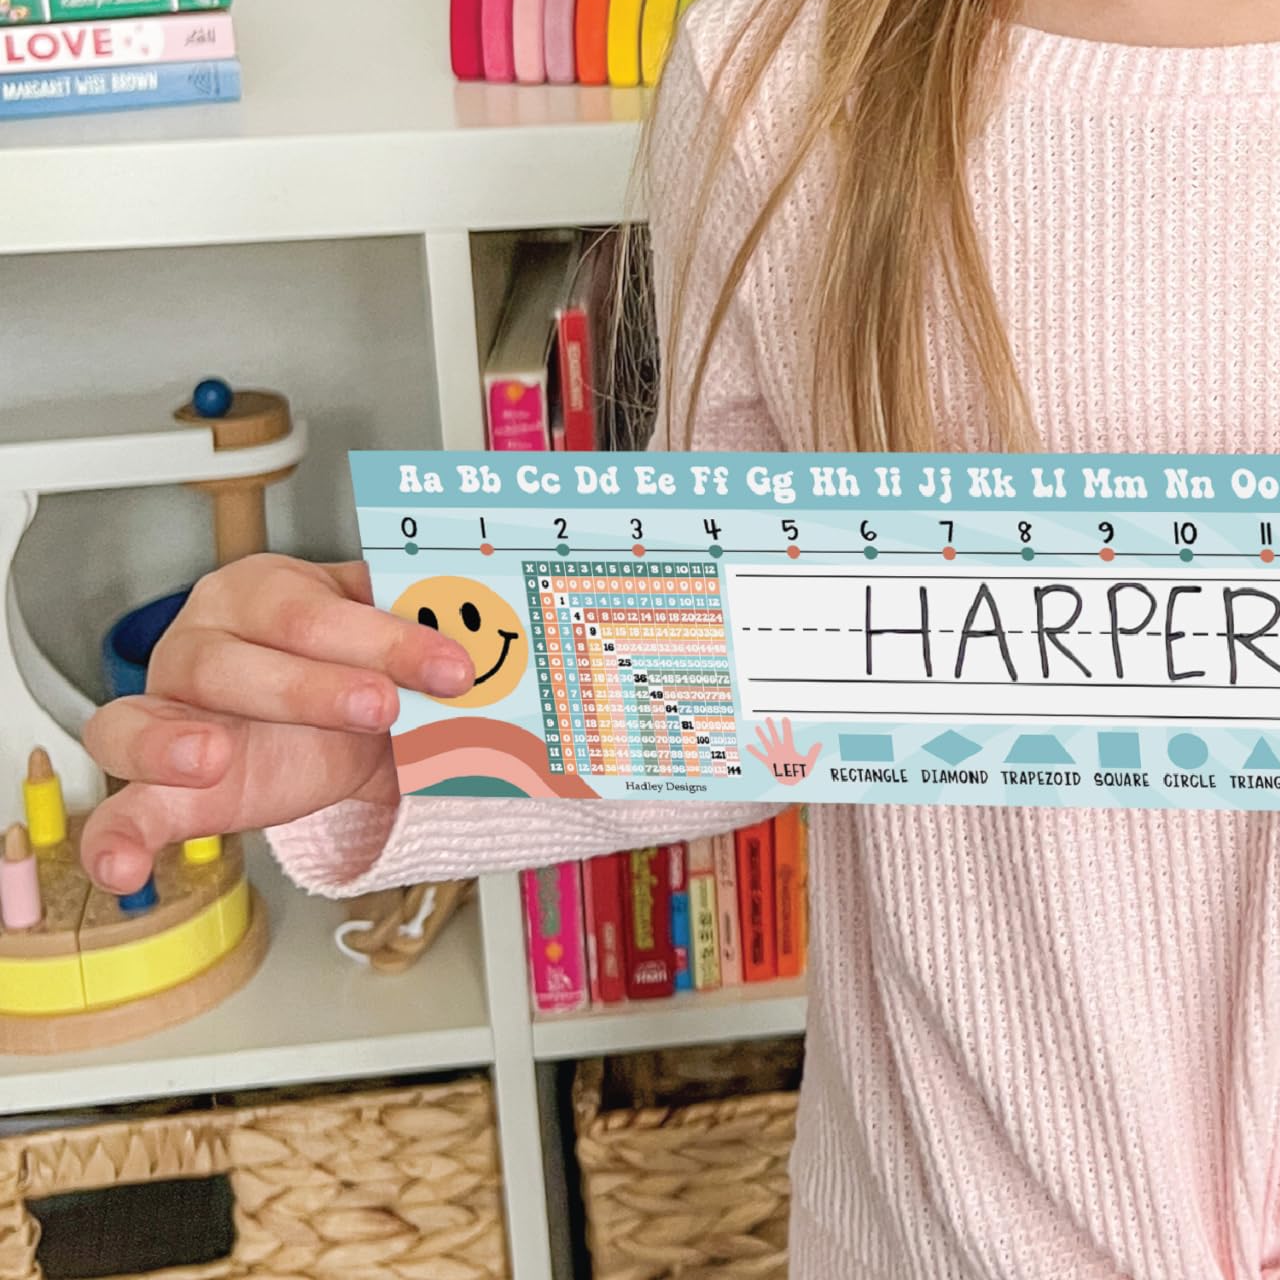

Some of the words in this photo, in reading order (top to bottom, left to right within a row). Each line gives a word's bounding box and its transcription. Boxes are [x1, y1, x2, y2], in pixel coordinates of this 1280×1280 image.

[5, 27, 113, 63] LOVE
[399, 464, 444, 493] Aa
[456, 465, 502, 494] Bb
[516, 465, 561, 494] Cc
[574, 465, 621, 495] Dd
[633, 465, 677, 495] Ee
[690, 466, 729, 495] Ff
[746, 466, 796, 504] Gg
[809, 466, 861, 497] Hh
[874, 466, 902, 497] Ii
[918, 467, 953, 504] Jj
[966, 467, 1017, 498] Kk
[1031, 467, 1067, 498] Ll
[1082, 467, 1148, 499] Mm
[1163, 468, 1215, 499] Nn
[1231, 468, 1280, 500] Oo
[401, 516, 418, 538] 0
[553, 517, 569, 539] 2
[630, 518, 643, 540] 3
[703, 518, 722, 541] 4
[781, 519, 799, 541] 5
[860, 520, 877, 542] 6
[939, 520, 954, 543] 7
[1018, 521, 1032, 543] 8
[1098, 521, 1114, 544] 9
[1174, 521, 1198, 545] 10
[1260, 522, 1272, 545] 11
[525, 564, 535, 573] X
[539, 564, 548, 573] 0
[554, 564, 561, 573] 1
[567, 564, 576, 573] 2
[580, 564, 589, 573] 3
[595, 564, 603, 574] 4
[609, 564, 617, 574] 5
[622, 564, 631, 574] 6
[635, 564, 644, 574] 7
[650, 565, 659, 574] 8
[664, 565, 673, 574] 9
[675, 565, 689, 574] 10
[691, 565, 701, 574] 11
[704, 565, 716, 574] 12
[528, 580, 536, 588] 0
[541, 580, 549, 589] 0
[532, 596, 537, 605] 1
[560, 596, 565, 606] 1
[532, 612, 540, 620] 2
[574, 612, 581, 620] 4
[534, 626, 542, 635] 3
[590, 626, 597, 636] 9
[536, 642, 544, 651] 4
[604, 642, 615, 652] 16
[538, 658, 546, 666] 5
[618, 658, 632, 667] 25
[540, 672, 548, 682] 6
[542, 688, 550, 698] 7
[650, 690, 664, 699] 49
[544, 703, 552, 712] 8
[666, 704, 678, 713] 64
[546, 718, 554, 727] 9
[682, 720, 694, 730] 81
[546, 734, 559, 742] 10
[696, 736, 710, 744] 100
[550, 748, 560, 757] 11
[711, 750, 726, 760] 121
[550, 763, 564, 772] 12
[773, 763, 806, 777] LEFT
[830, 768, 909, 783] RECTANGLE
[921, 769, 989, 784] DIAMOND
[1001, 771, 1082, 786] TRAPEZOID
[1094, 772, 1150, 787] SQUARE
[1164, 774, 1217, 788] CIRCLE
[626, 781, 663, 793] Hadley
[666, 782, 707, 794] Designs
